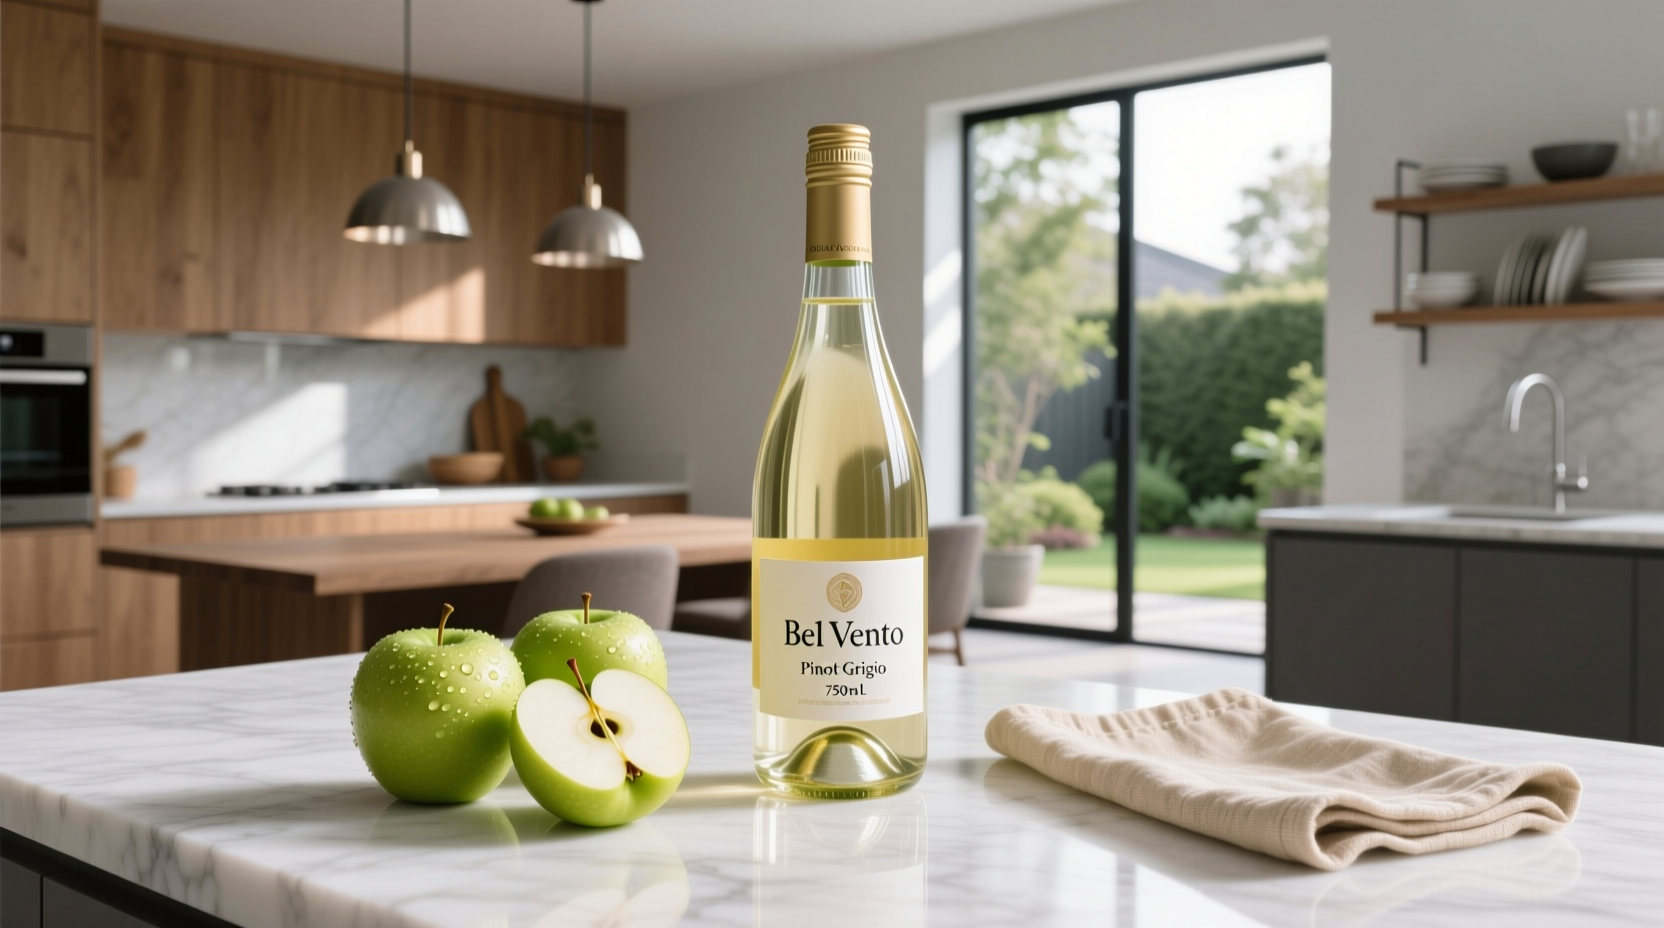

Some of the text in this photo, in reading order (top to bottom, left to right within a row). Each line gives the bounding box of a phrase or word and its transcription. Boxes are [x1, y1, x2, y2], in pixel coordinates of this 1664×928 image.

[784, 619, 904, 648] Bel Vento
[800, 661, 887, 680] Pinot Grigio
